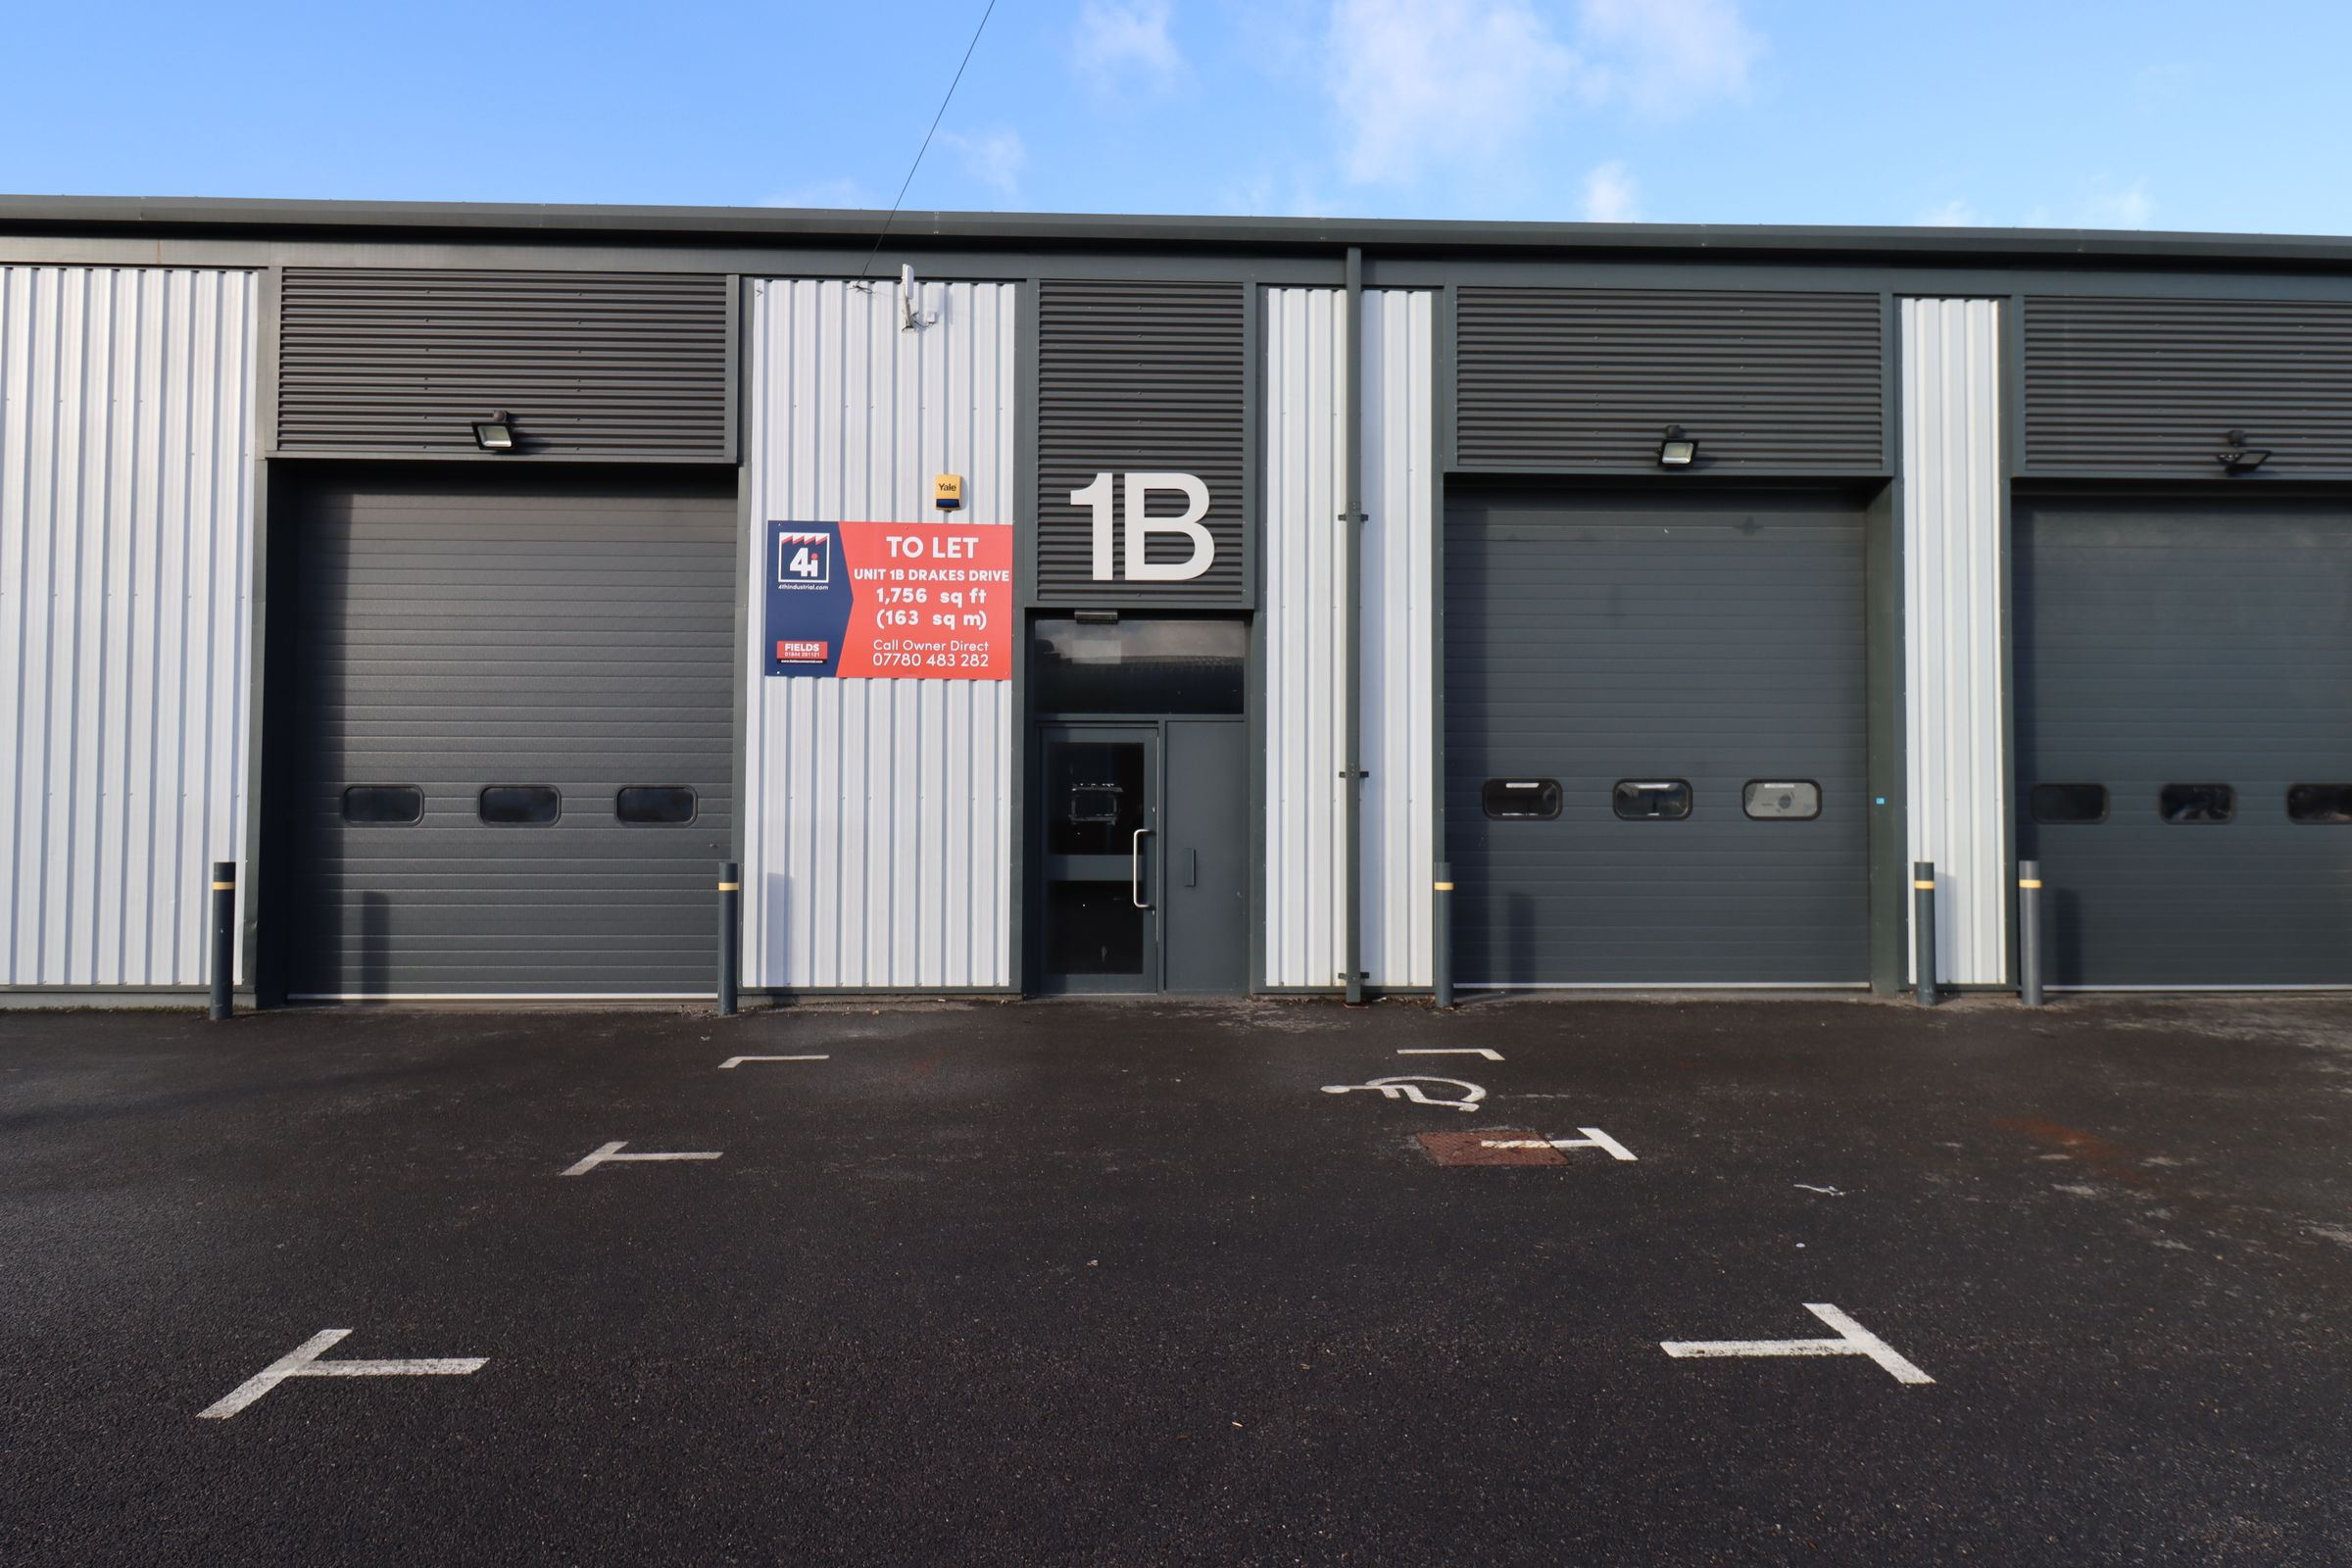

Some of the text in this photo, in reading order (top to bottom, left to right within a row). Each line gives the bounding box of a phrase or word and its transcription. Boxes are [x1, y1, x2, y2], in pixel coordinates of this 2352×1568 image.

[938, 482, 957, 492] Yale
[1070, 472, 1215, 581] 1B
[886, 536, 979, 559] TO LET
[854, 568, 1010, 581] UNIT 1B DRAKES DRIVE
[876, 588, 987, 608] 1,756 sq ft
[876, 609, 987, 630] (163 sq m)
[785, 643, 820, 652] FIELDS
[873, 639, 989, 652] Call Owner Direct
[872, 653, 989, 666] 07780 483 282
